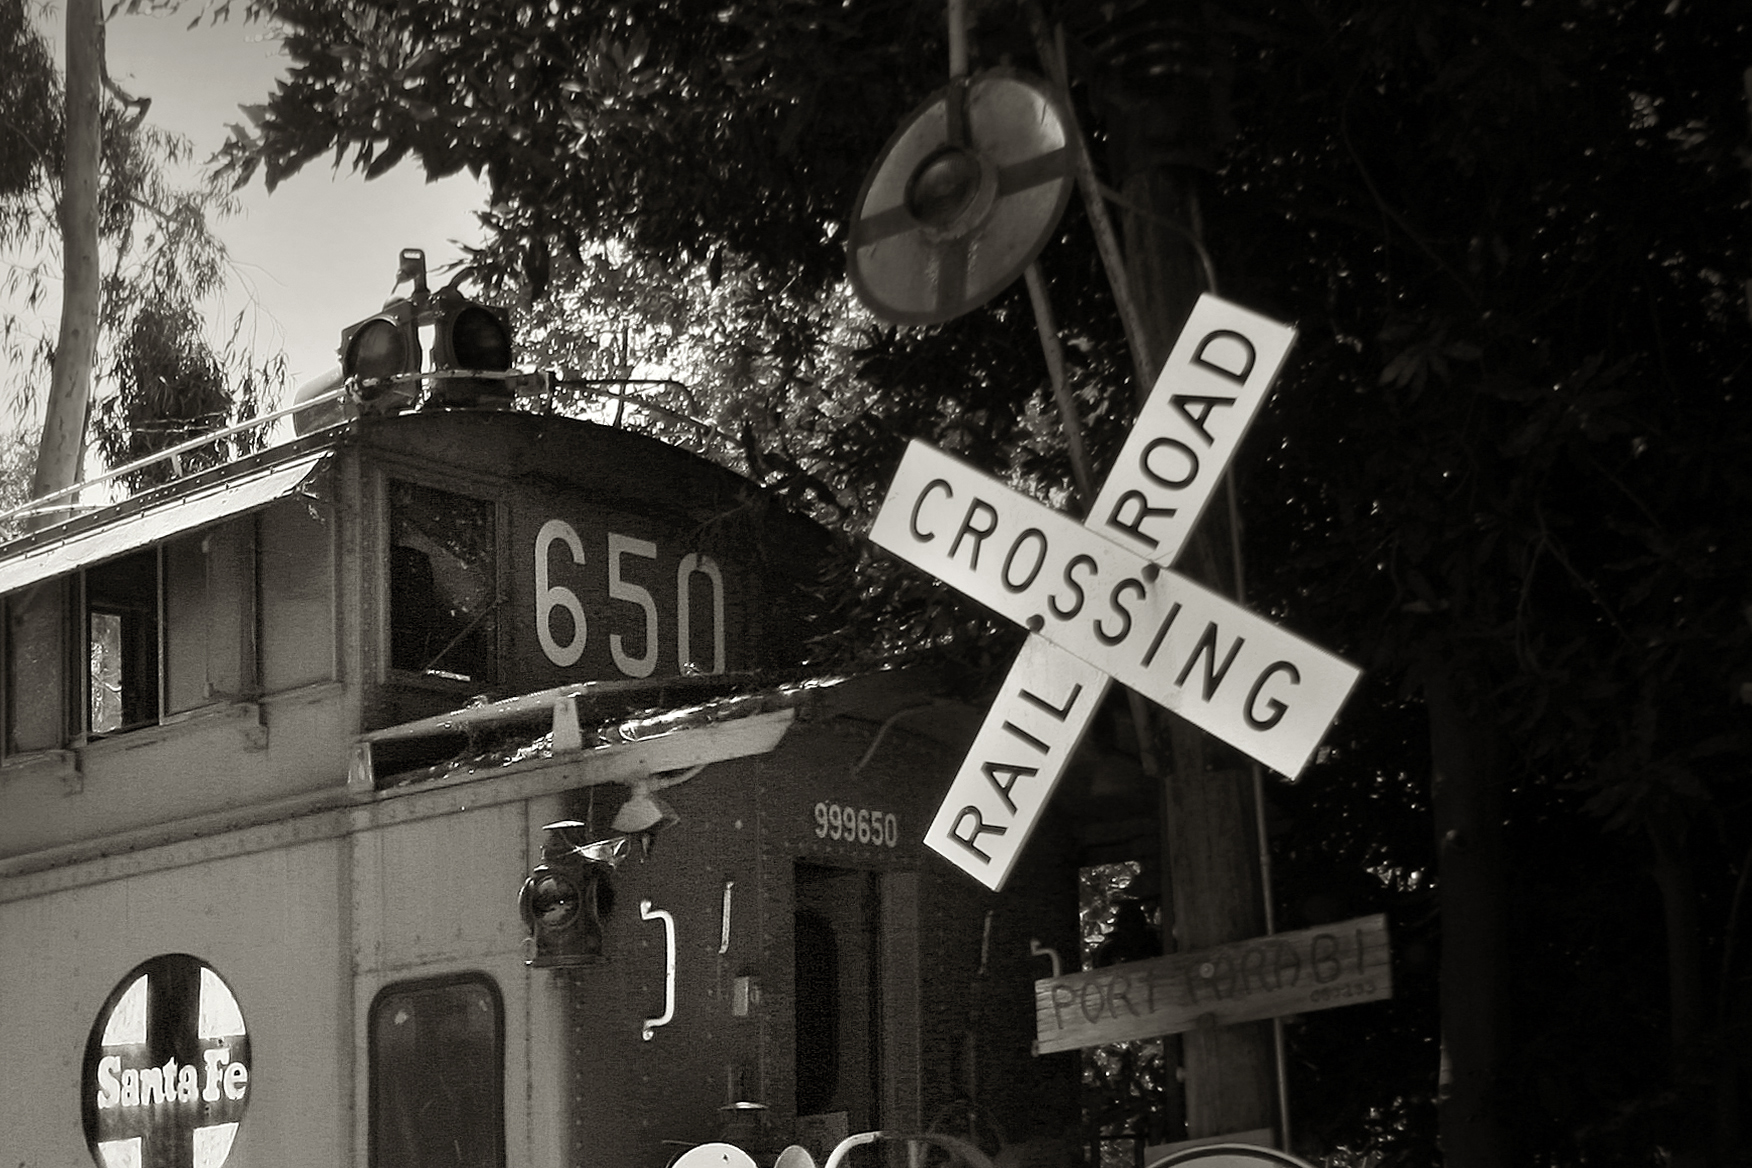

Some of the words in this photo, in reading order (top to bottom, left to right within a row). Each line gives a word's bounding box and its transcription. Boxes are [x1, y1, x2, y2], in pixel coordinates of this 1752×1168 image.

[1107, 328, 1258, 551] ROAD
[534, 518, 726, 679] 650
[907, 477, 1302, 733] CROSSING
[813, 801, 899, 848] 999650
[948, 681, 1083, 865] RAIL
[1051, 966, 1157, 1030] PORT
[97, 1055, 198, 1110] Santa
[202, 1048, 248, 1102] Fe
